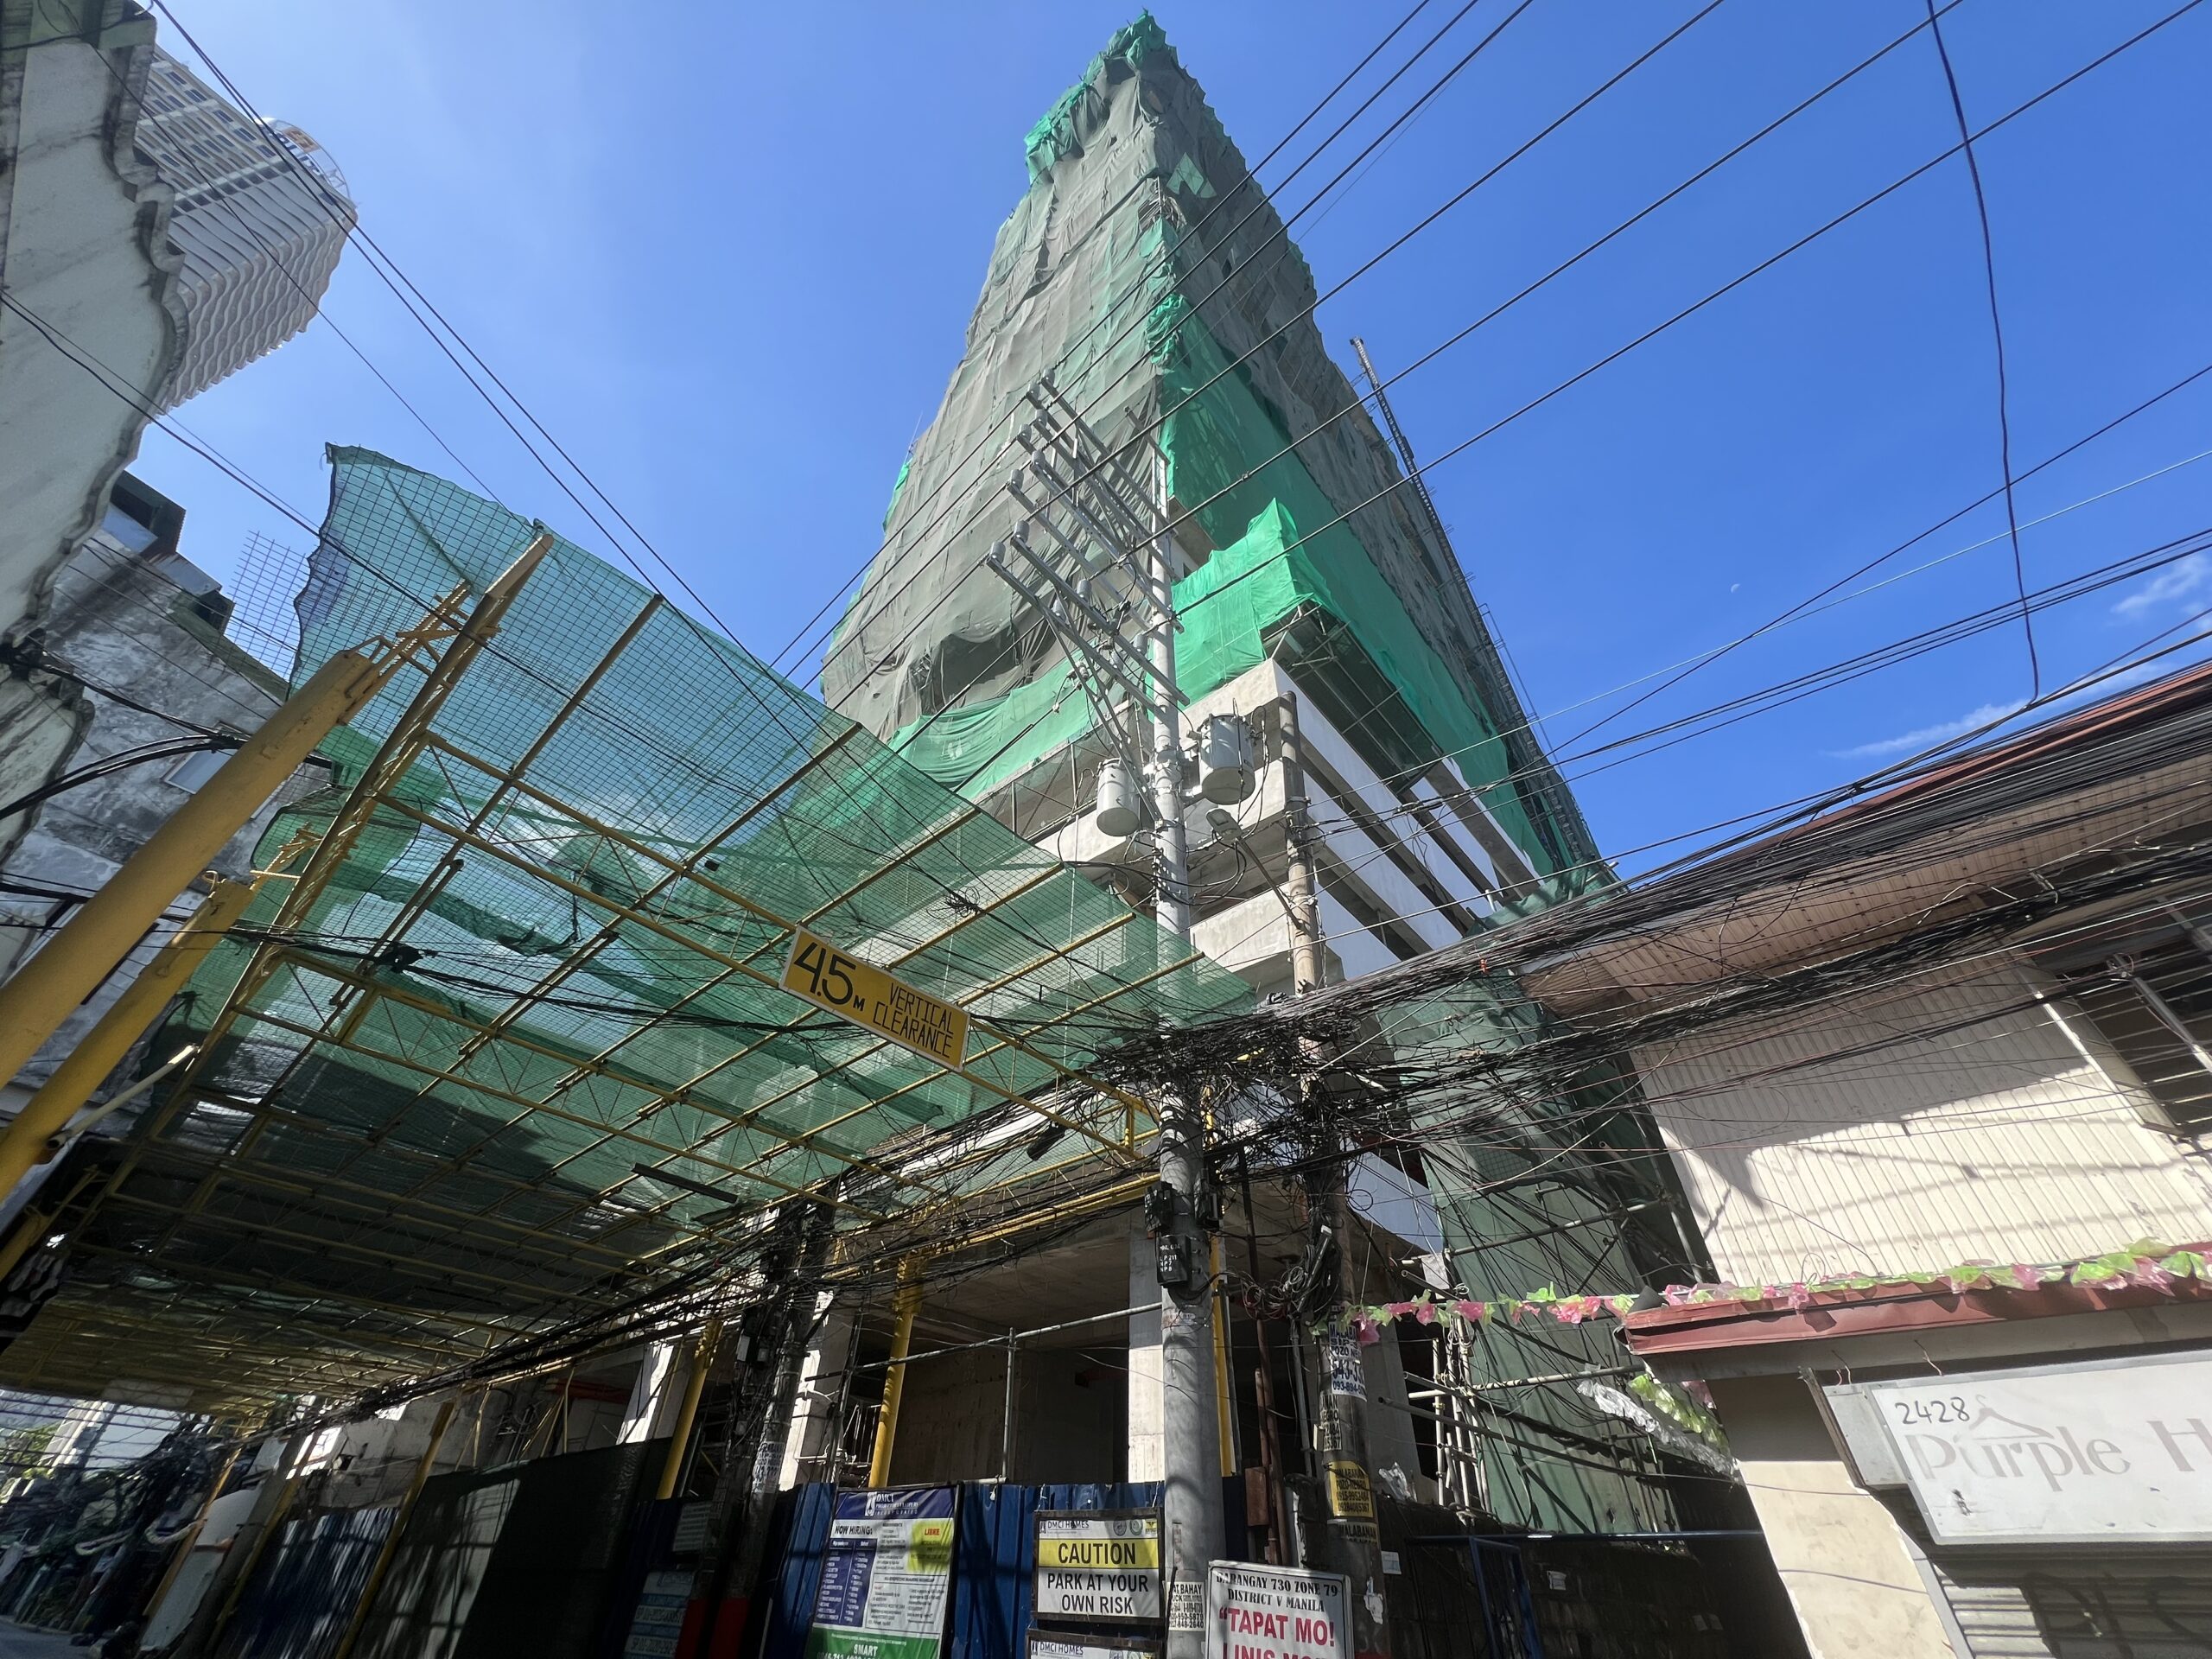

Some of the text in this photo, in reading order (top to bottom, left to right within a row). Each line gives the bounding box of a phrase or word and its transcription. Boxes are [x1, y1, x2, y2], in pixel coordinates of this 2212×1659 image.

[794, 941, 856, 1006] 4.5
[888, 982, 954, 1035] VERTICAL
[873, 1001, 954, 1058] CLEARANCE
[1894, 1395, 1970, 1425] 2428
[1904, 1426, 2132, 1493] Purple
[835, 1526, 849, 1535] NOW
[1065, 1520, 1090, 1529] HMES
[1058, 1542, 1136, 1565] CAUTION
[1047, 1573, 1083, 1590] PARK
[1087, 1573, 1104, 1591] AT
[1108, 1574, 1149, 1592] YOUR
[1179, 1584, 1202, 1594] BAHAY
[1216, 1571, 1338, 1597] BARANGAY 730 ZONE 79
[1061, 1594, 1134, 1615] OWN RISK
[1228, 1587, 1325, 1612] DISTRICT V MANILA
[1295, 1617, 1335, 1647] MO!
[854, 1644, 878, 1656] SMART
[1039, 1642, 1084, 1656] DMCI HOMES
